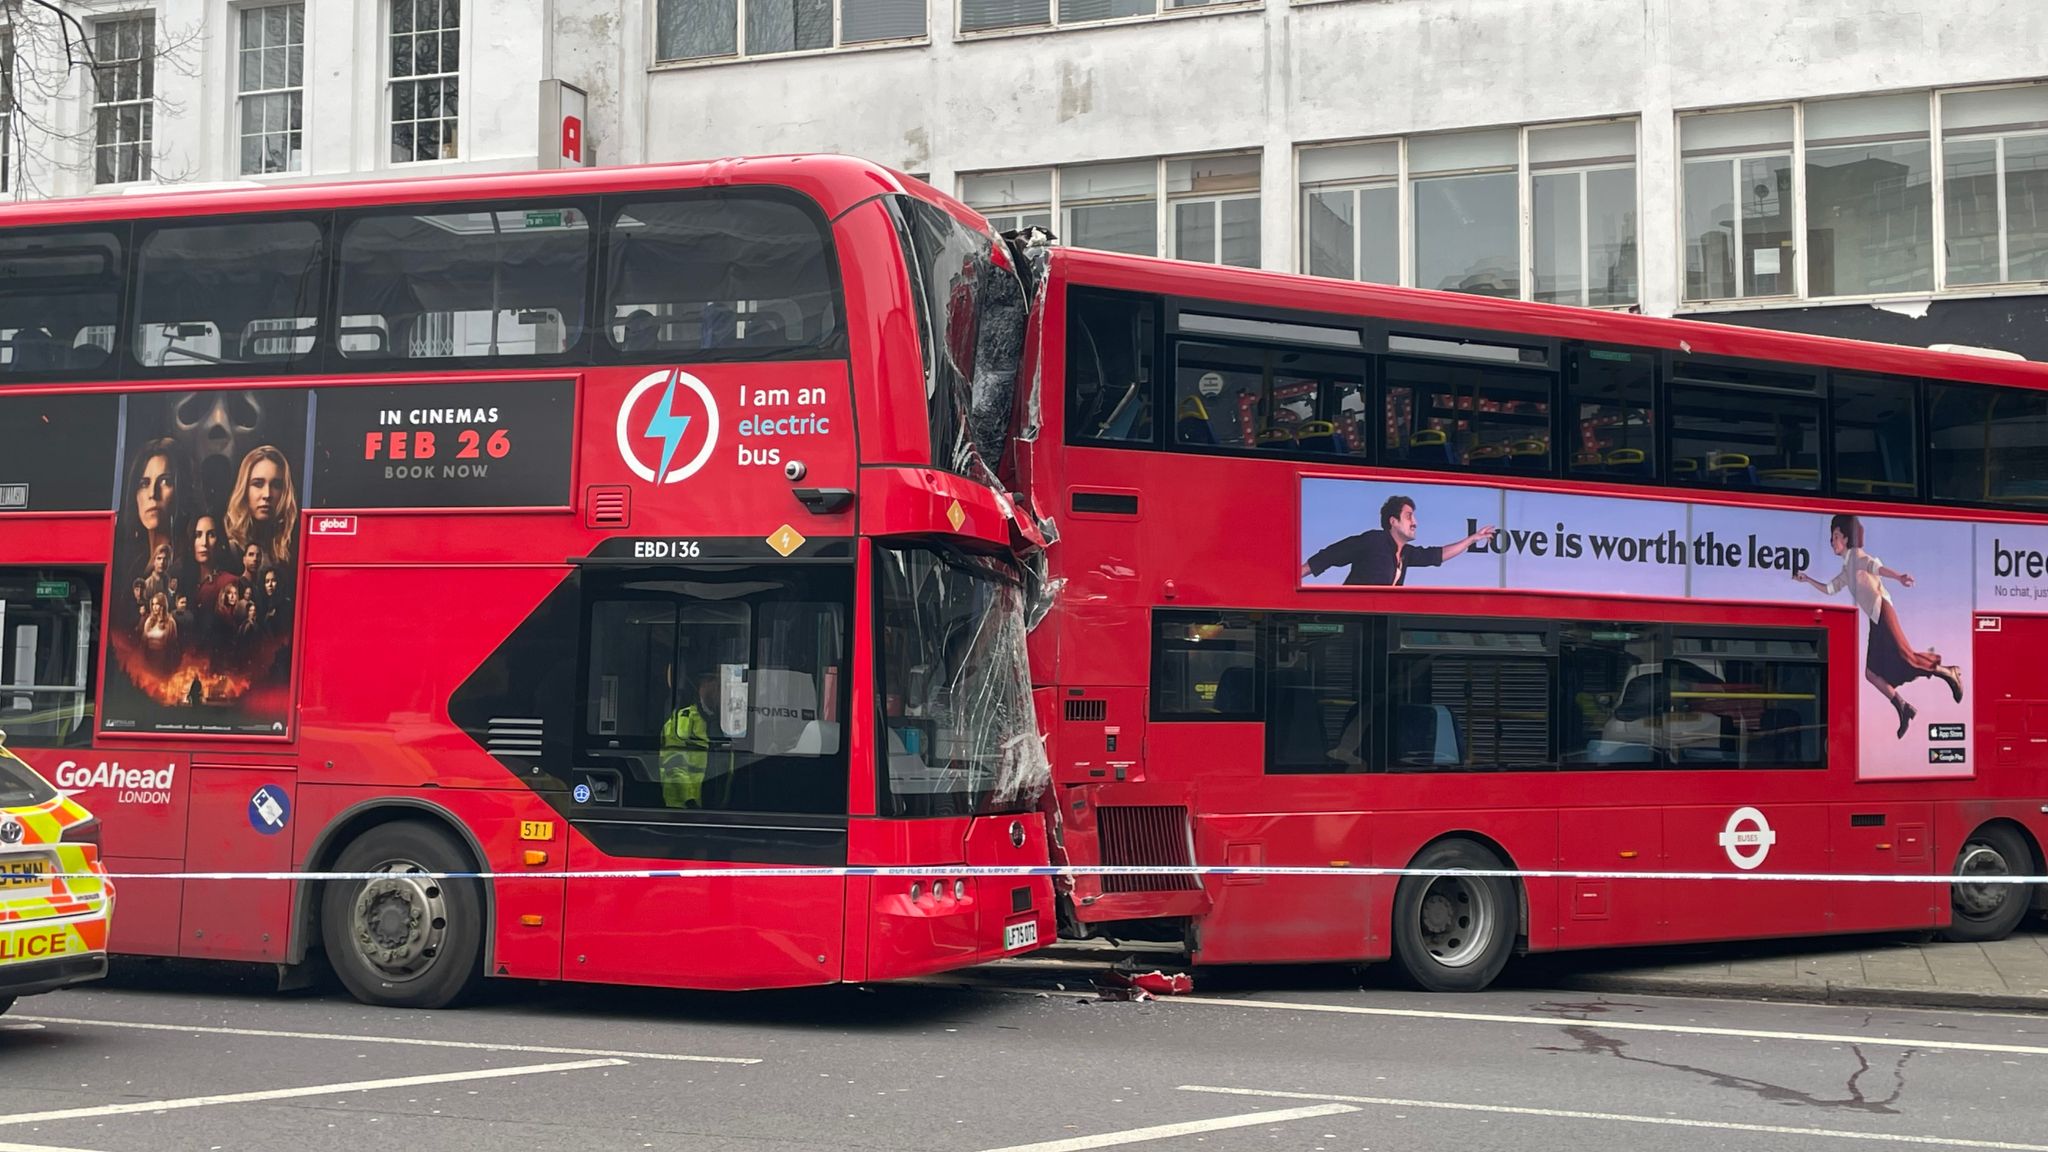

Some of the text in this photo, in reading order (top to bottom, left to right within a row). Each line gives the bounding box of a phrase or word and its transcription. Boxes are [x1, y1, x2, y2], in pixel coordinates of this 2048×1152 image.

[740, 385, 826, 407] I am an
[380, 407, 499, 425] IN CINEMAS
[738, 412, 830, 436] electric
[365, 429, 511, 460] FEB 26
[738, 443, 780, 465] bus
[384, 464, 488, 479] BOOK NOW
[320, 518, 348, 531] global
[634, 541, 701, 558] EBD136
[1466, 518, 1810, 579] Love is worth the leap
[1994, 539, 2048, 578] bre
[1994, 585, 2048, 600] No chat, jus
[56, 760, 175, 789] GoAhead
[118, 790, 171, 804] LONDON
[524, 822, 548, 837] 511
[1737, 834, 1758, 842] BUSES
